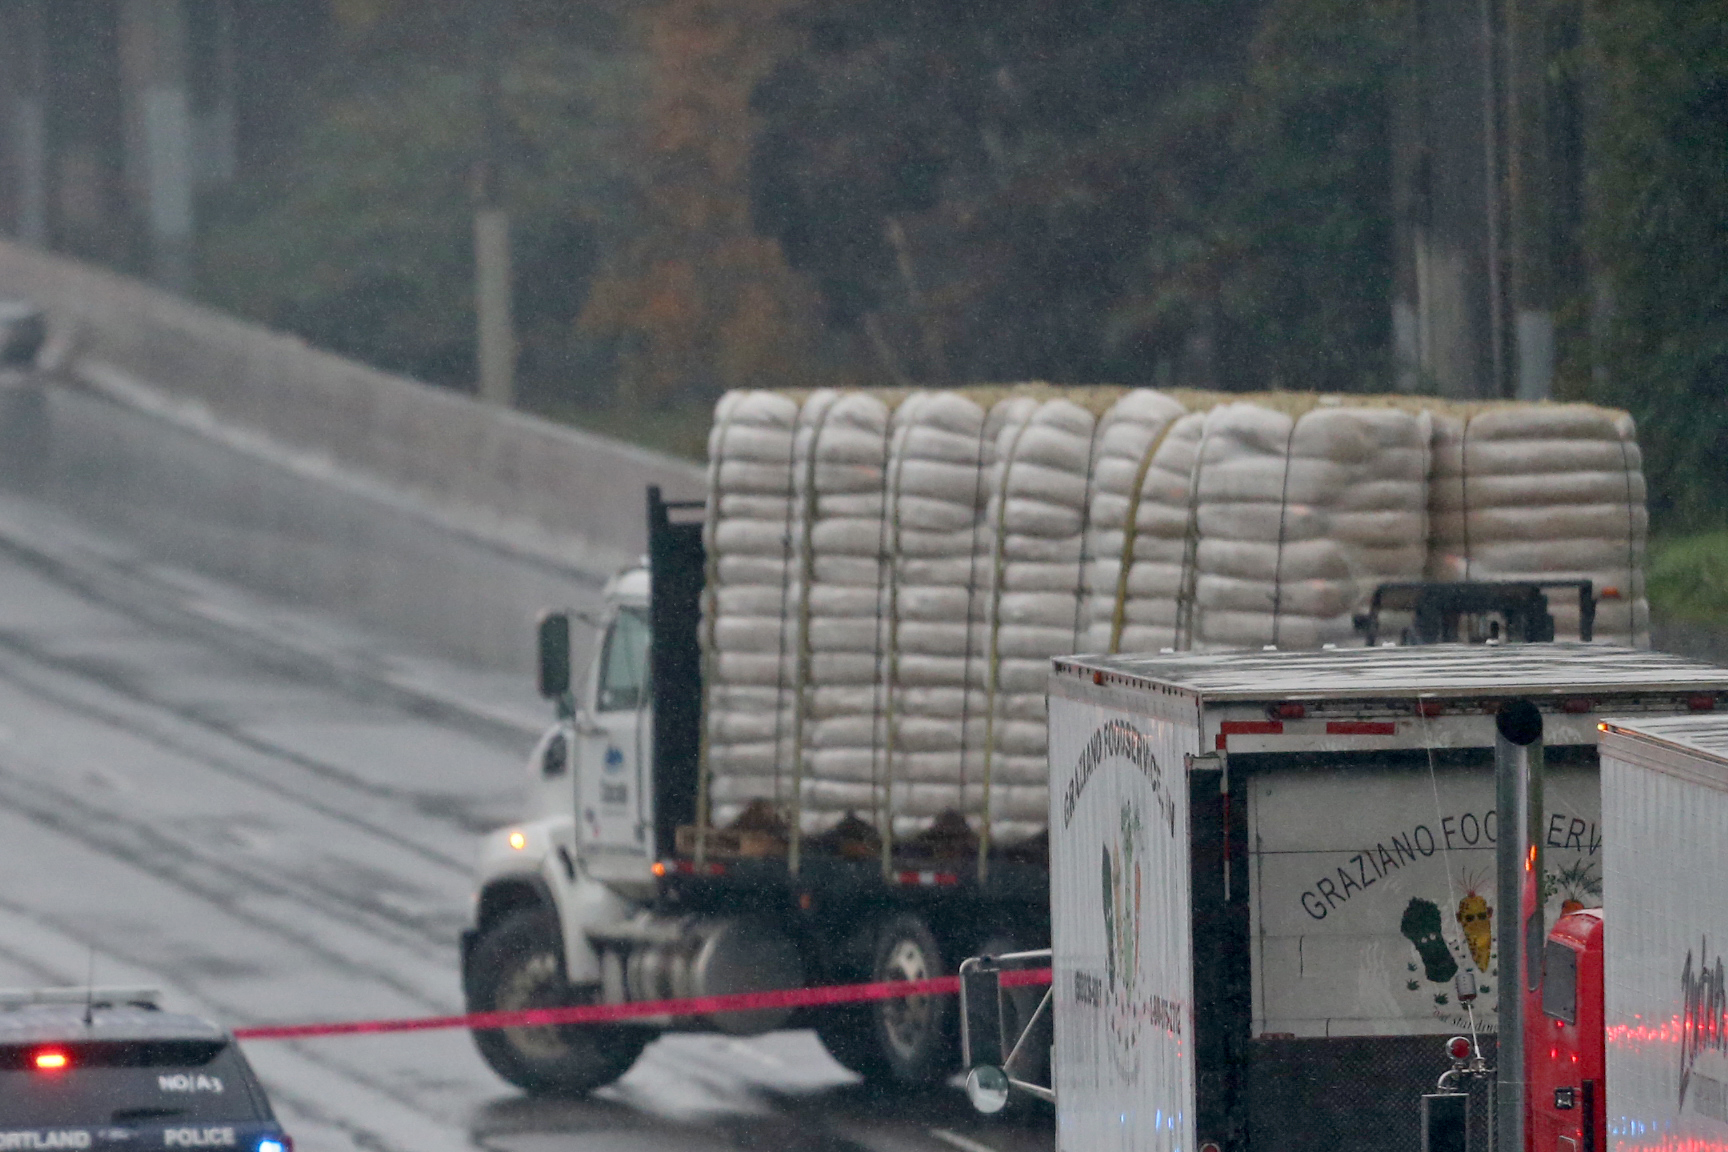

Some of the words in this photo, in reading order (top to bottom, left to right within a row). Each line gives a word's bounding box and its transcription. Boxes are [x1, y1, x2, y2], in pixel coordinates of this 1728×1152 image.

[1063, 727, 1102, 830] GRAZIANO
[1300, 824, 1436, 921] GRAZIANO
[163, 1126, 236, 1147] POLICE
